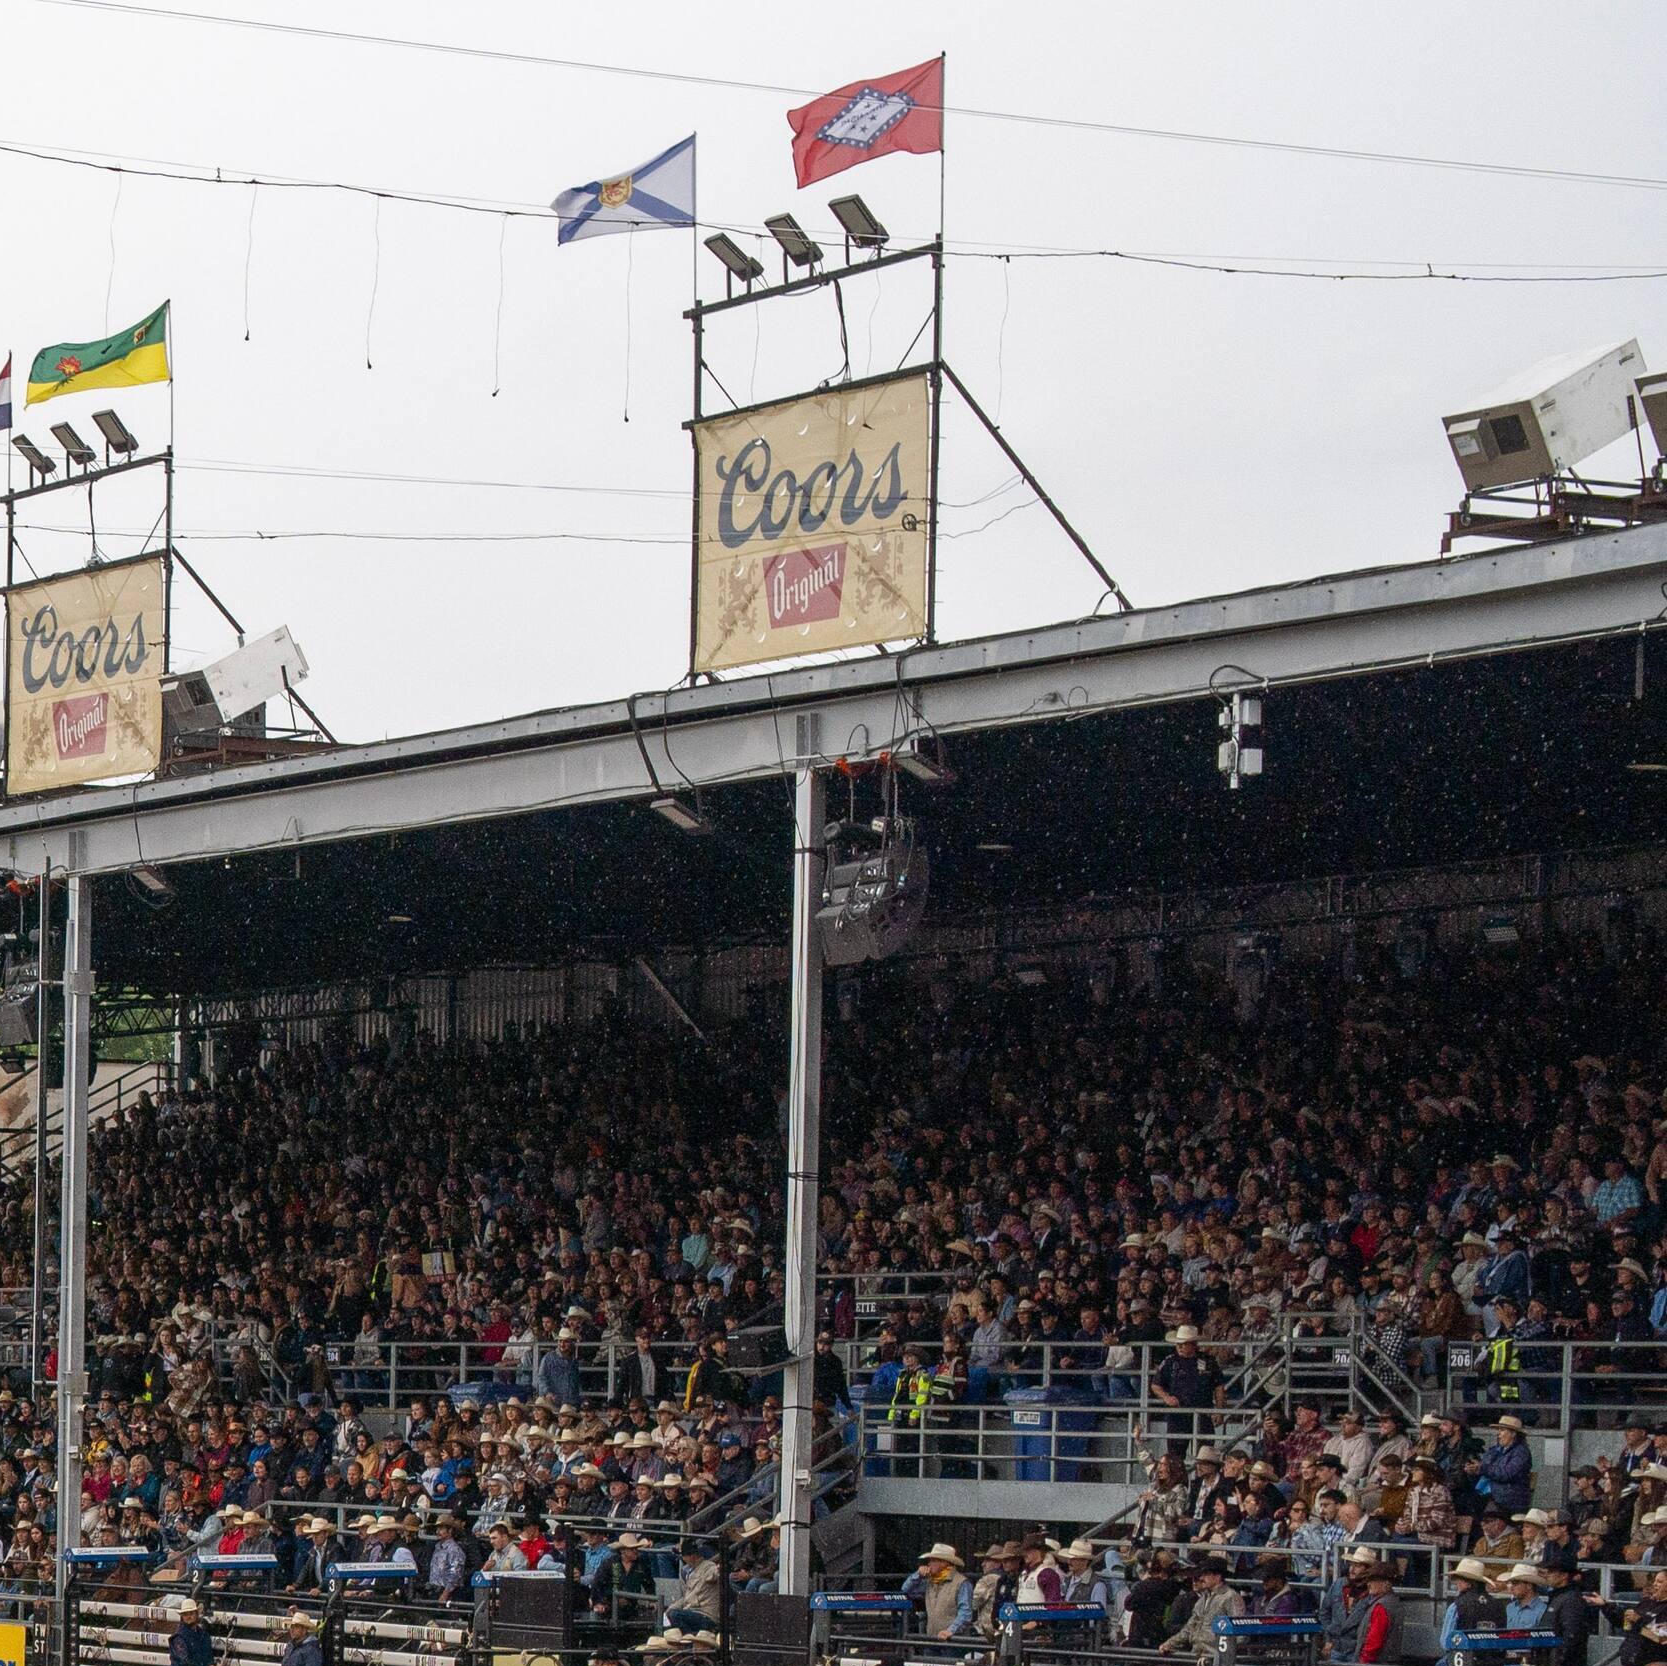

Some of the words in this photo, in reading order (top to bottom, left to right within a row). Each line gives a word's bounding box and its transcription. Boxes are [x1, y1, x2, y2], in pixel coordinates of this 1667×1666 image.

[716, 437, 909, 548] Coors
[773, 550, 839, 620] Original
[22, 605, 150, 694] Coors
[57, 701, 107, 755] Original
[1451, 1355, 1470, 1367] 206
[192, 1570, 199, 1583] 2
[328, 1579, 335, 1592] 3
[34, 1623, 47, 1638] FW
[1004, 1621, 1013, 1637] 4
[34, 1640, 45, 1654] ST
[1218, 1636, 1227, 1653] 5
